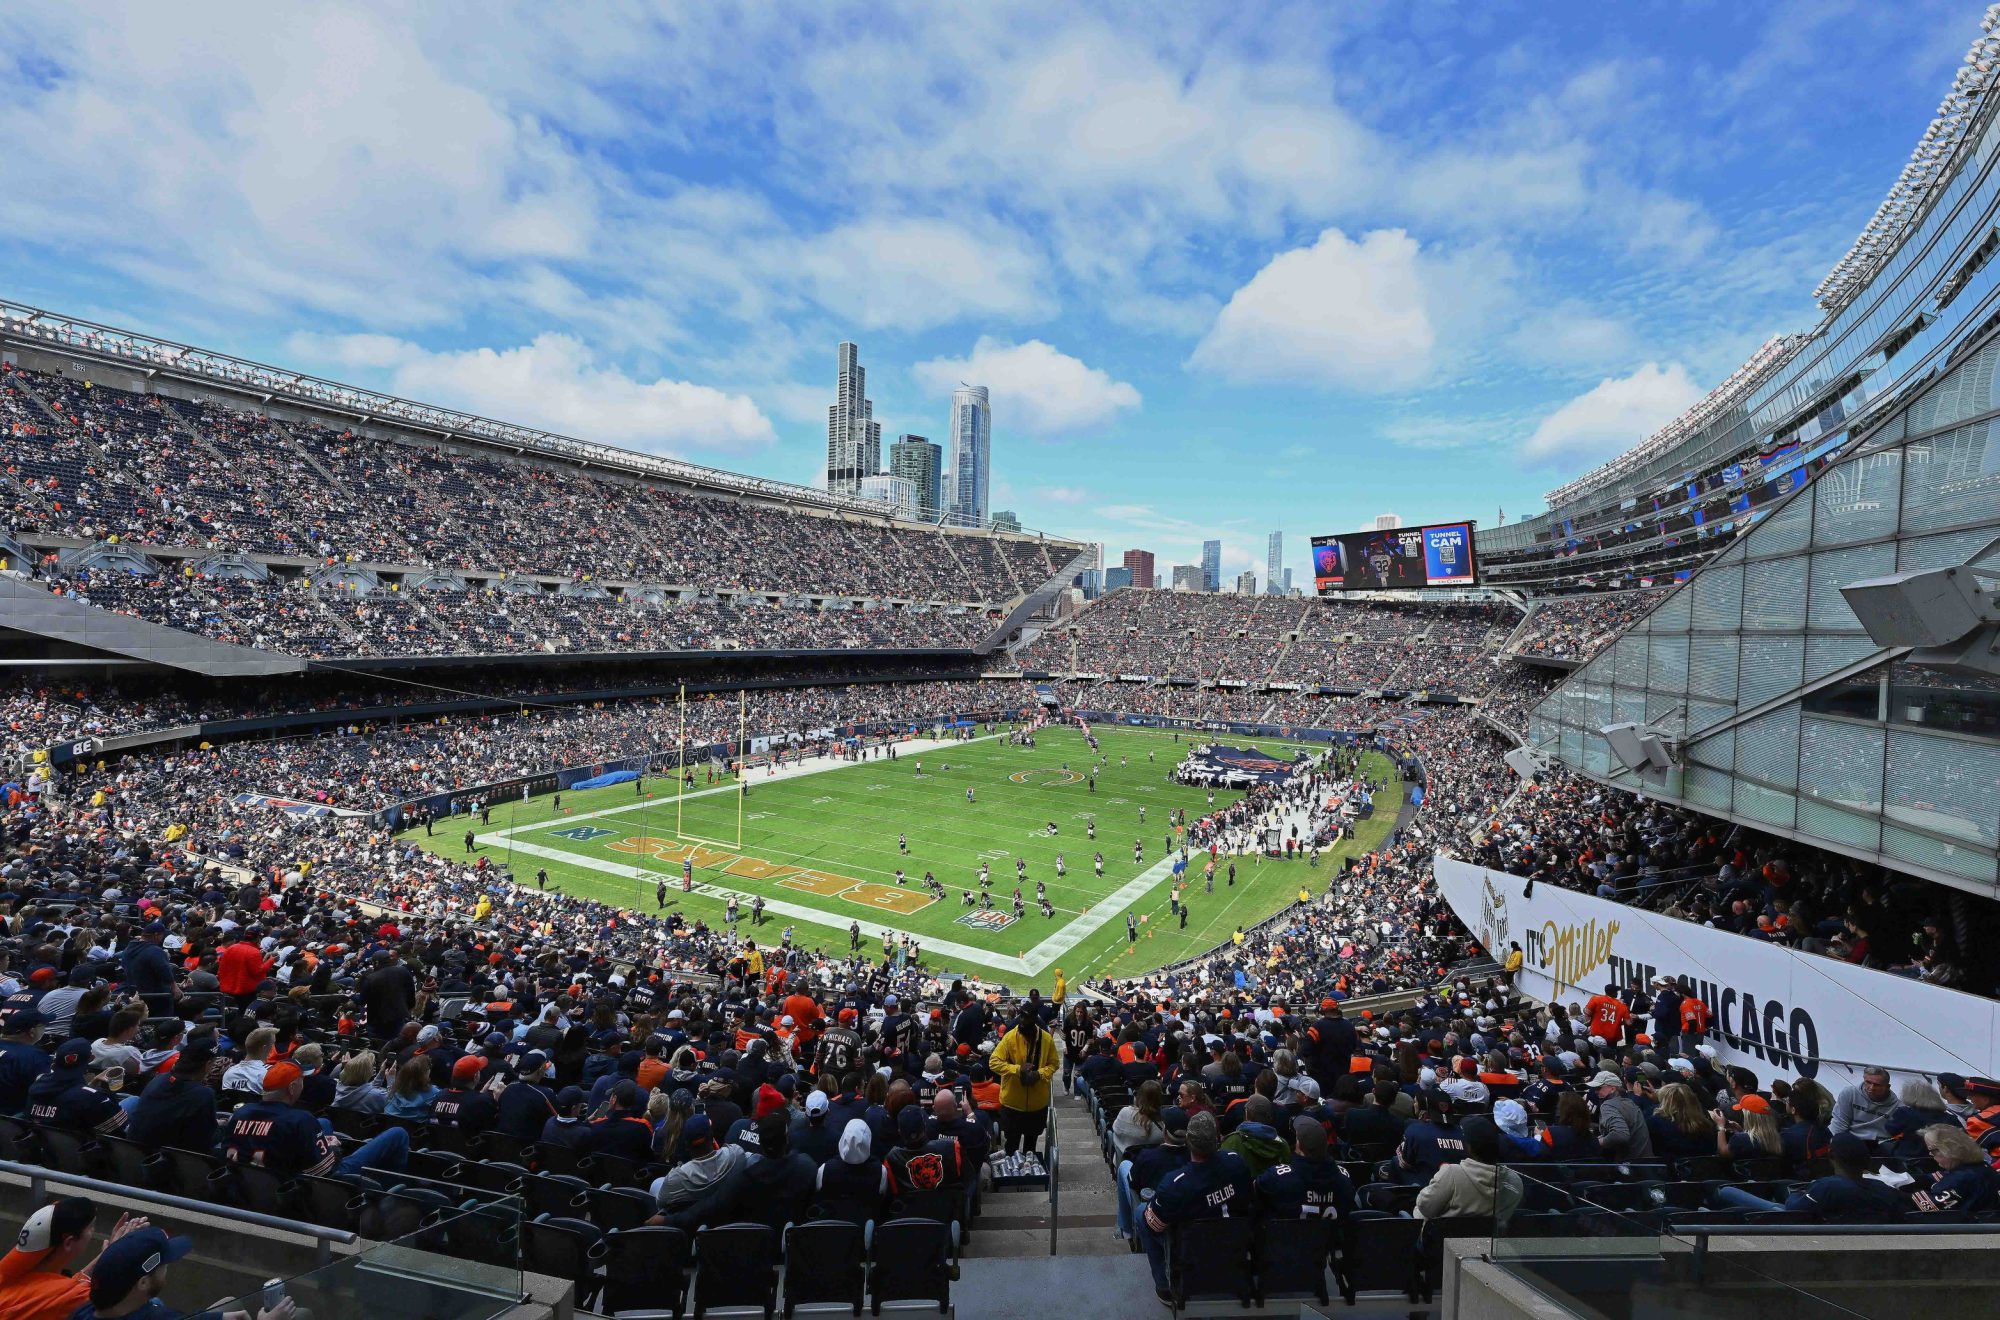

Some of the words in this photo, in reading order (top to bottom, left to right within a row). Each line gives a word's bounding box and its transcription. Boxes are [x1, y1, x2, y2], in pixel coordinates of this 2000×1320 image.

[1398, 536, 1422, 545] CAM
[1429, 531, 1461, 539] TUNNEL
[1430, 537, 1462, 548] CAM
[1375, 560, 1388, 573] 32
[604, 836, 938, 915] BEARS
[1526, 929, 1546, 969] IT'S
[1543, 917, 1620, 1001] Miller
[871, 980, 885, 994] 54
[1600, 1008, 1616, 1025] 34
[1070, 1029, 1086, 1047] 90
[824, 1042, 847, 1068] 76
[1537, 1082, 1548, 1093] 96
[31, 1103, 57, 1118] FIELDS
[233, 1119, 273, 1137] PAYTON
[1437, 1137, 1463, 1150] PAYTON
[1206, 1183, 1235, 1207] FIELDS
